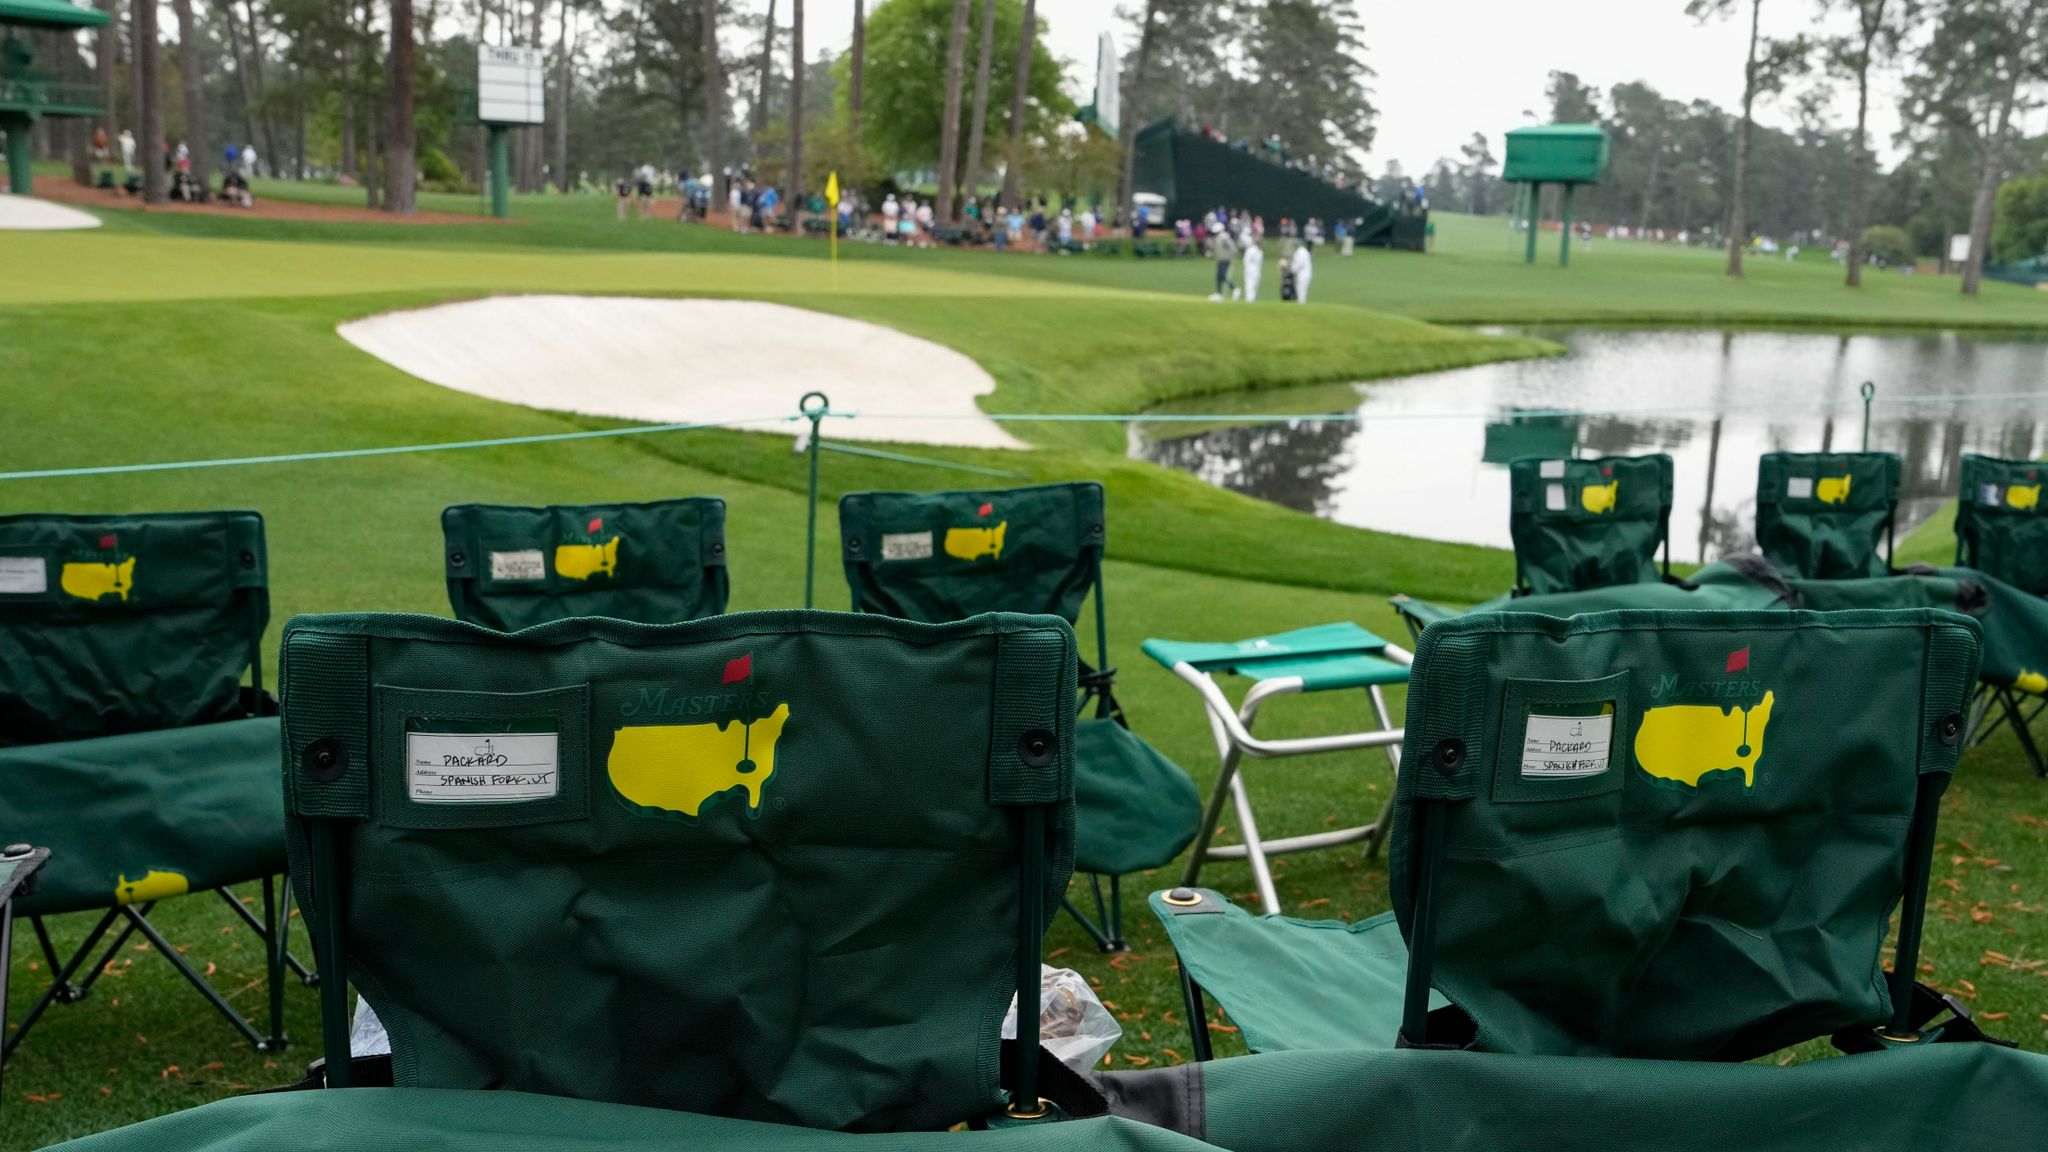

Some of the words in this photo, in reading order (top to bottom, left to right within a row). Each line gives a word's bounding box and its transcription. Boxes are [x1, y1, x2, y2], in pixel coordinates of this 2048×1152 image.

[1549, 740, 1592, 753] PACKARD
[443, 754, 508, 767] PACKARD
[440, 775, 486, 786] SPANISH
